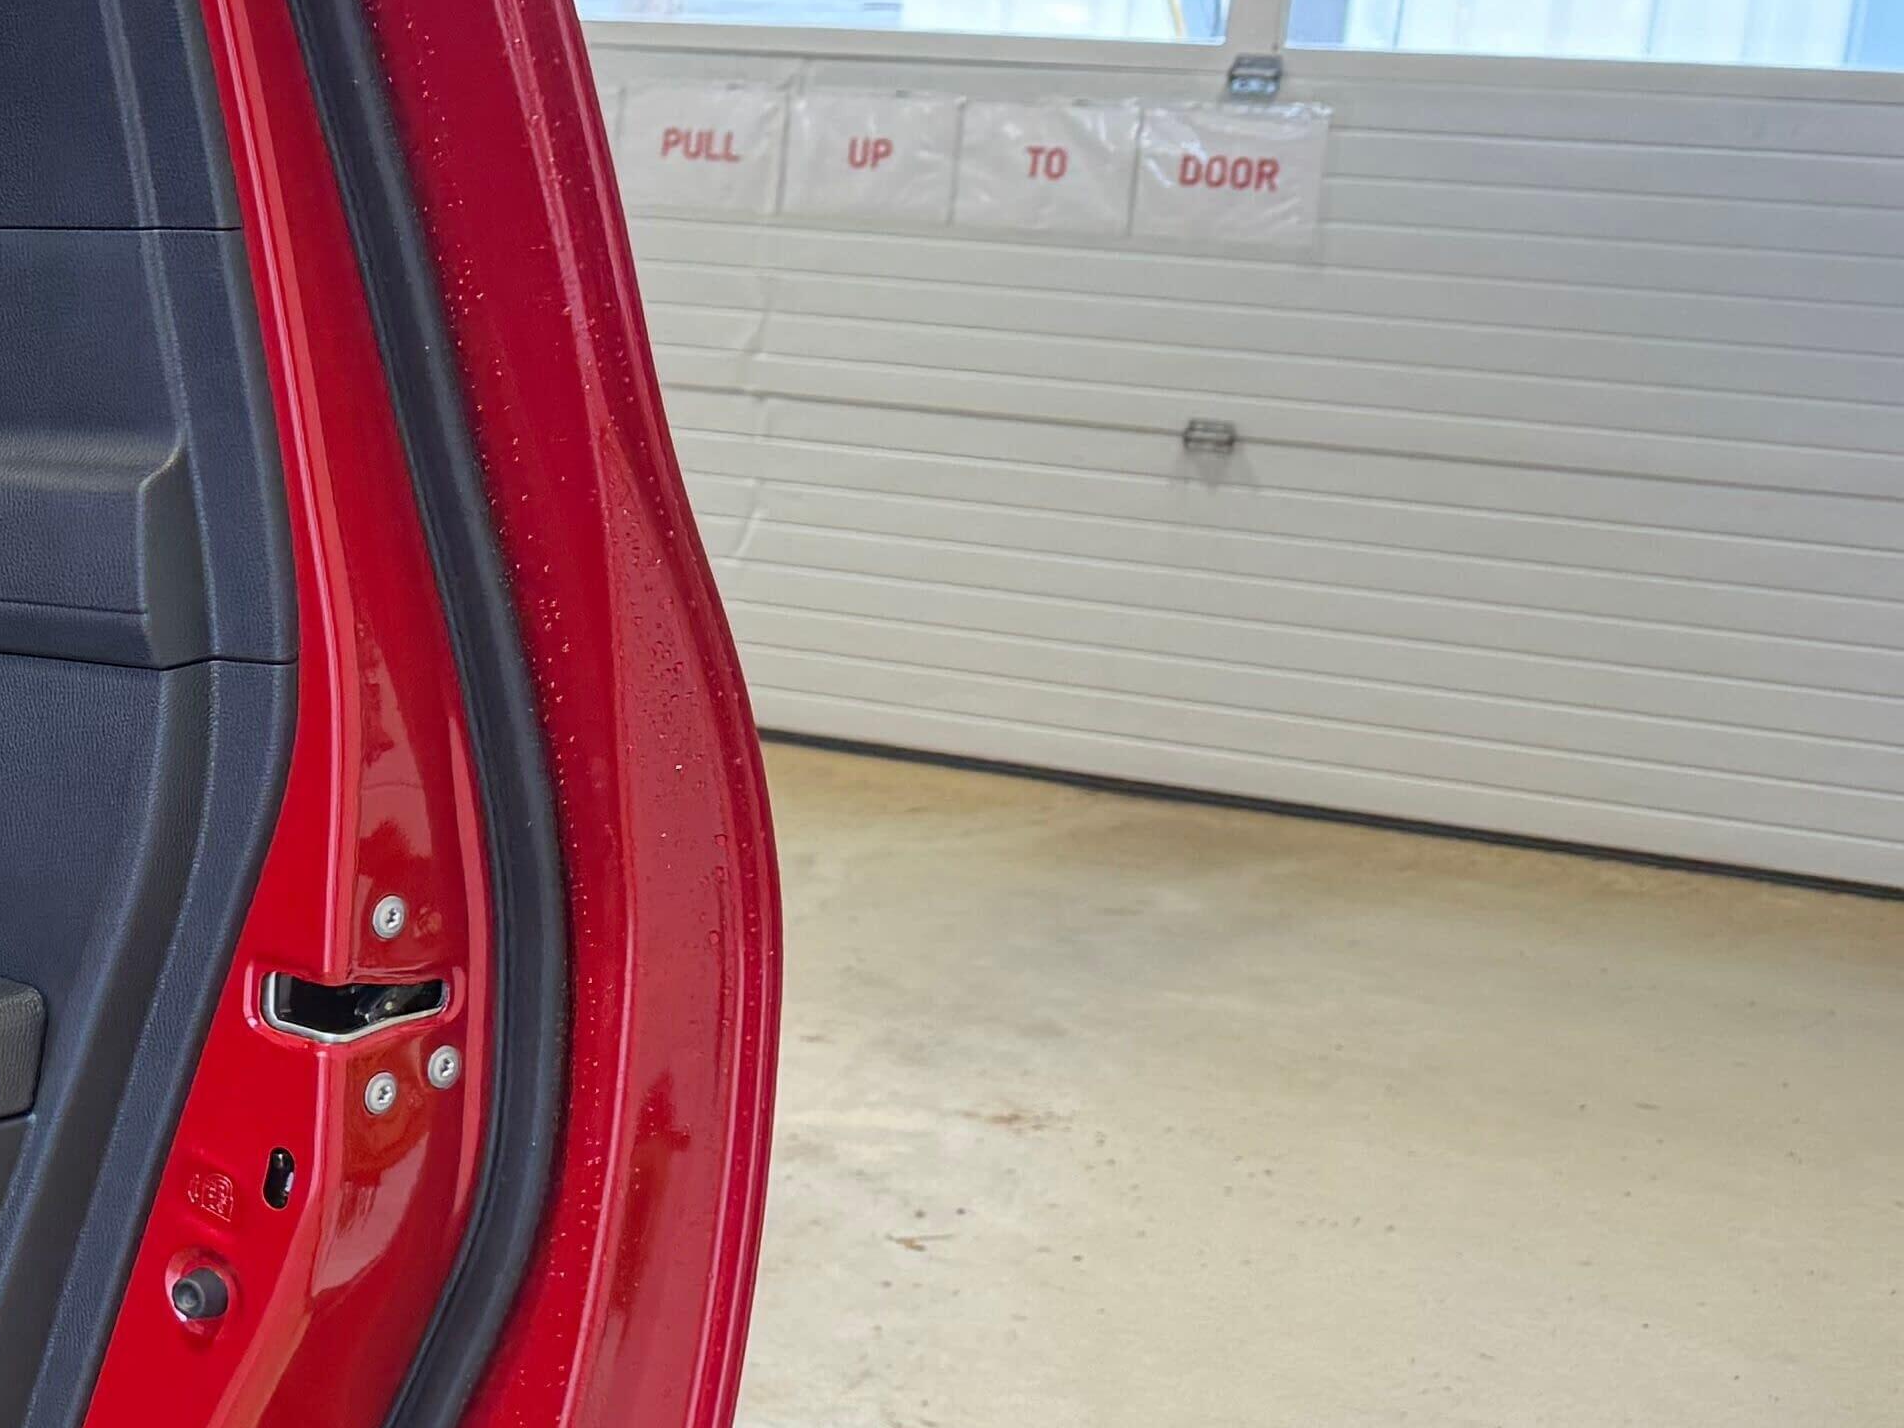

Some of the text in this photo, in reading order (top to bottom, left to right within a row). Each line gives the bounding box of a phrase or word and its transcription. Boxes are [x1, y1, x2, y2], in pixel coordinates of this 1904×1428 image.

[659, 127, 1281, 193] PULL UP TO DOOR
